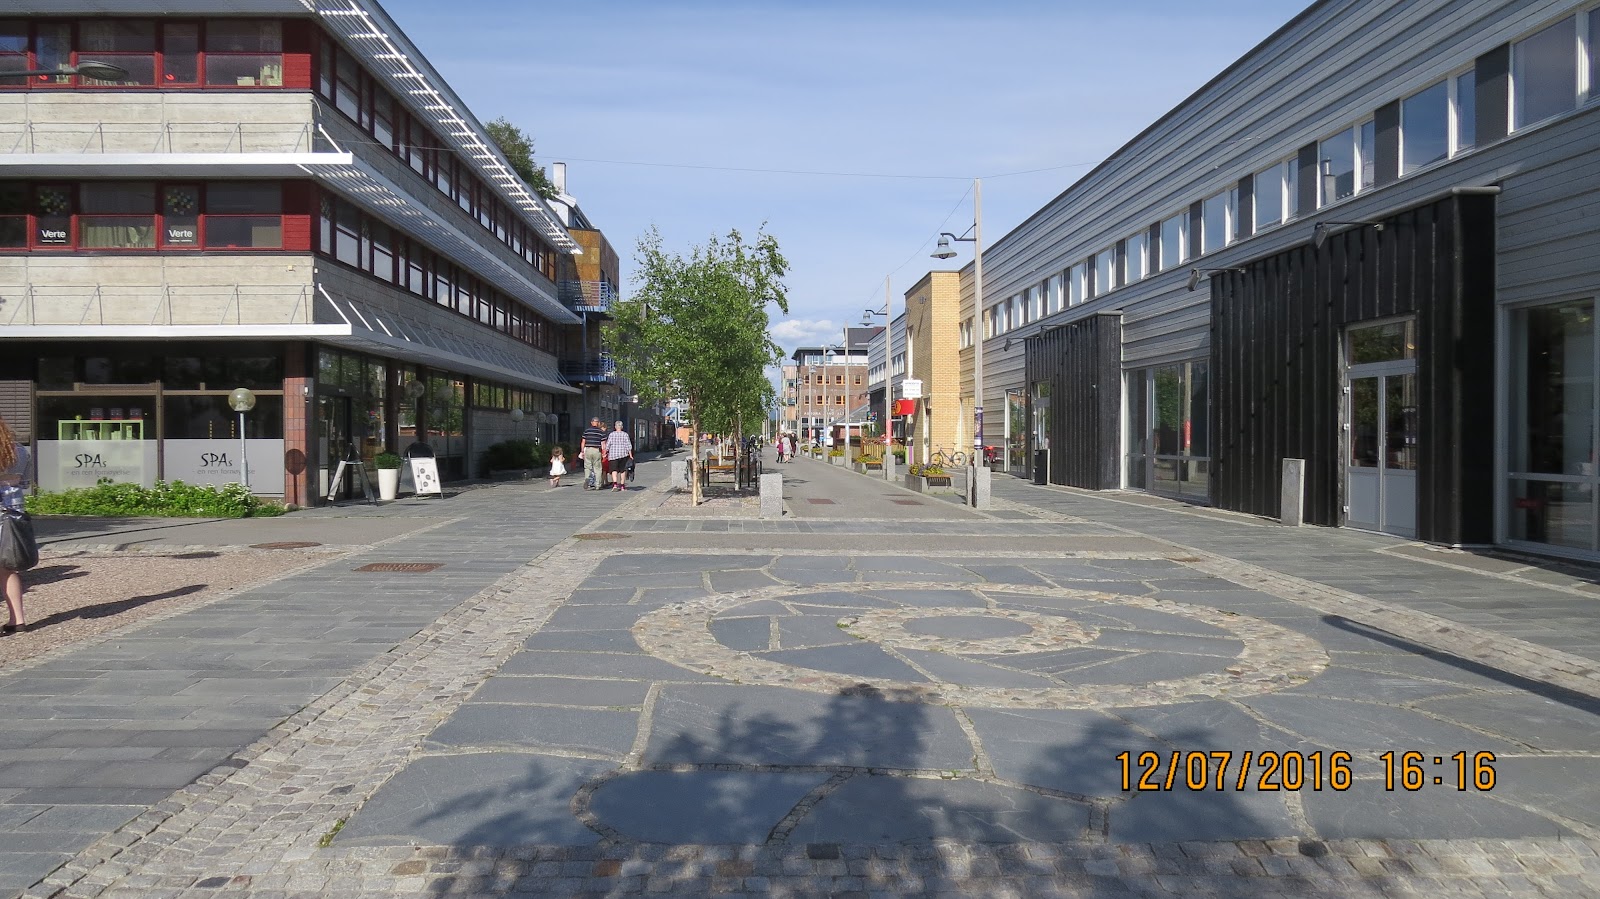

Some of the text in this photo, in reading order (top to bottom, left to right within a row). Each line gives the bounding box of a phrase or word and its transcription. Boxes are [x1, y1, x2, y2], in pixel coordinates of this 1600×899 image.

[41, 230, 66, 238] Verte
[168, 230, 193, 238] Verte
[74, 453, 107, 468] SPAs
[200, 452, 233, 467] SPAs
